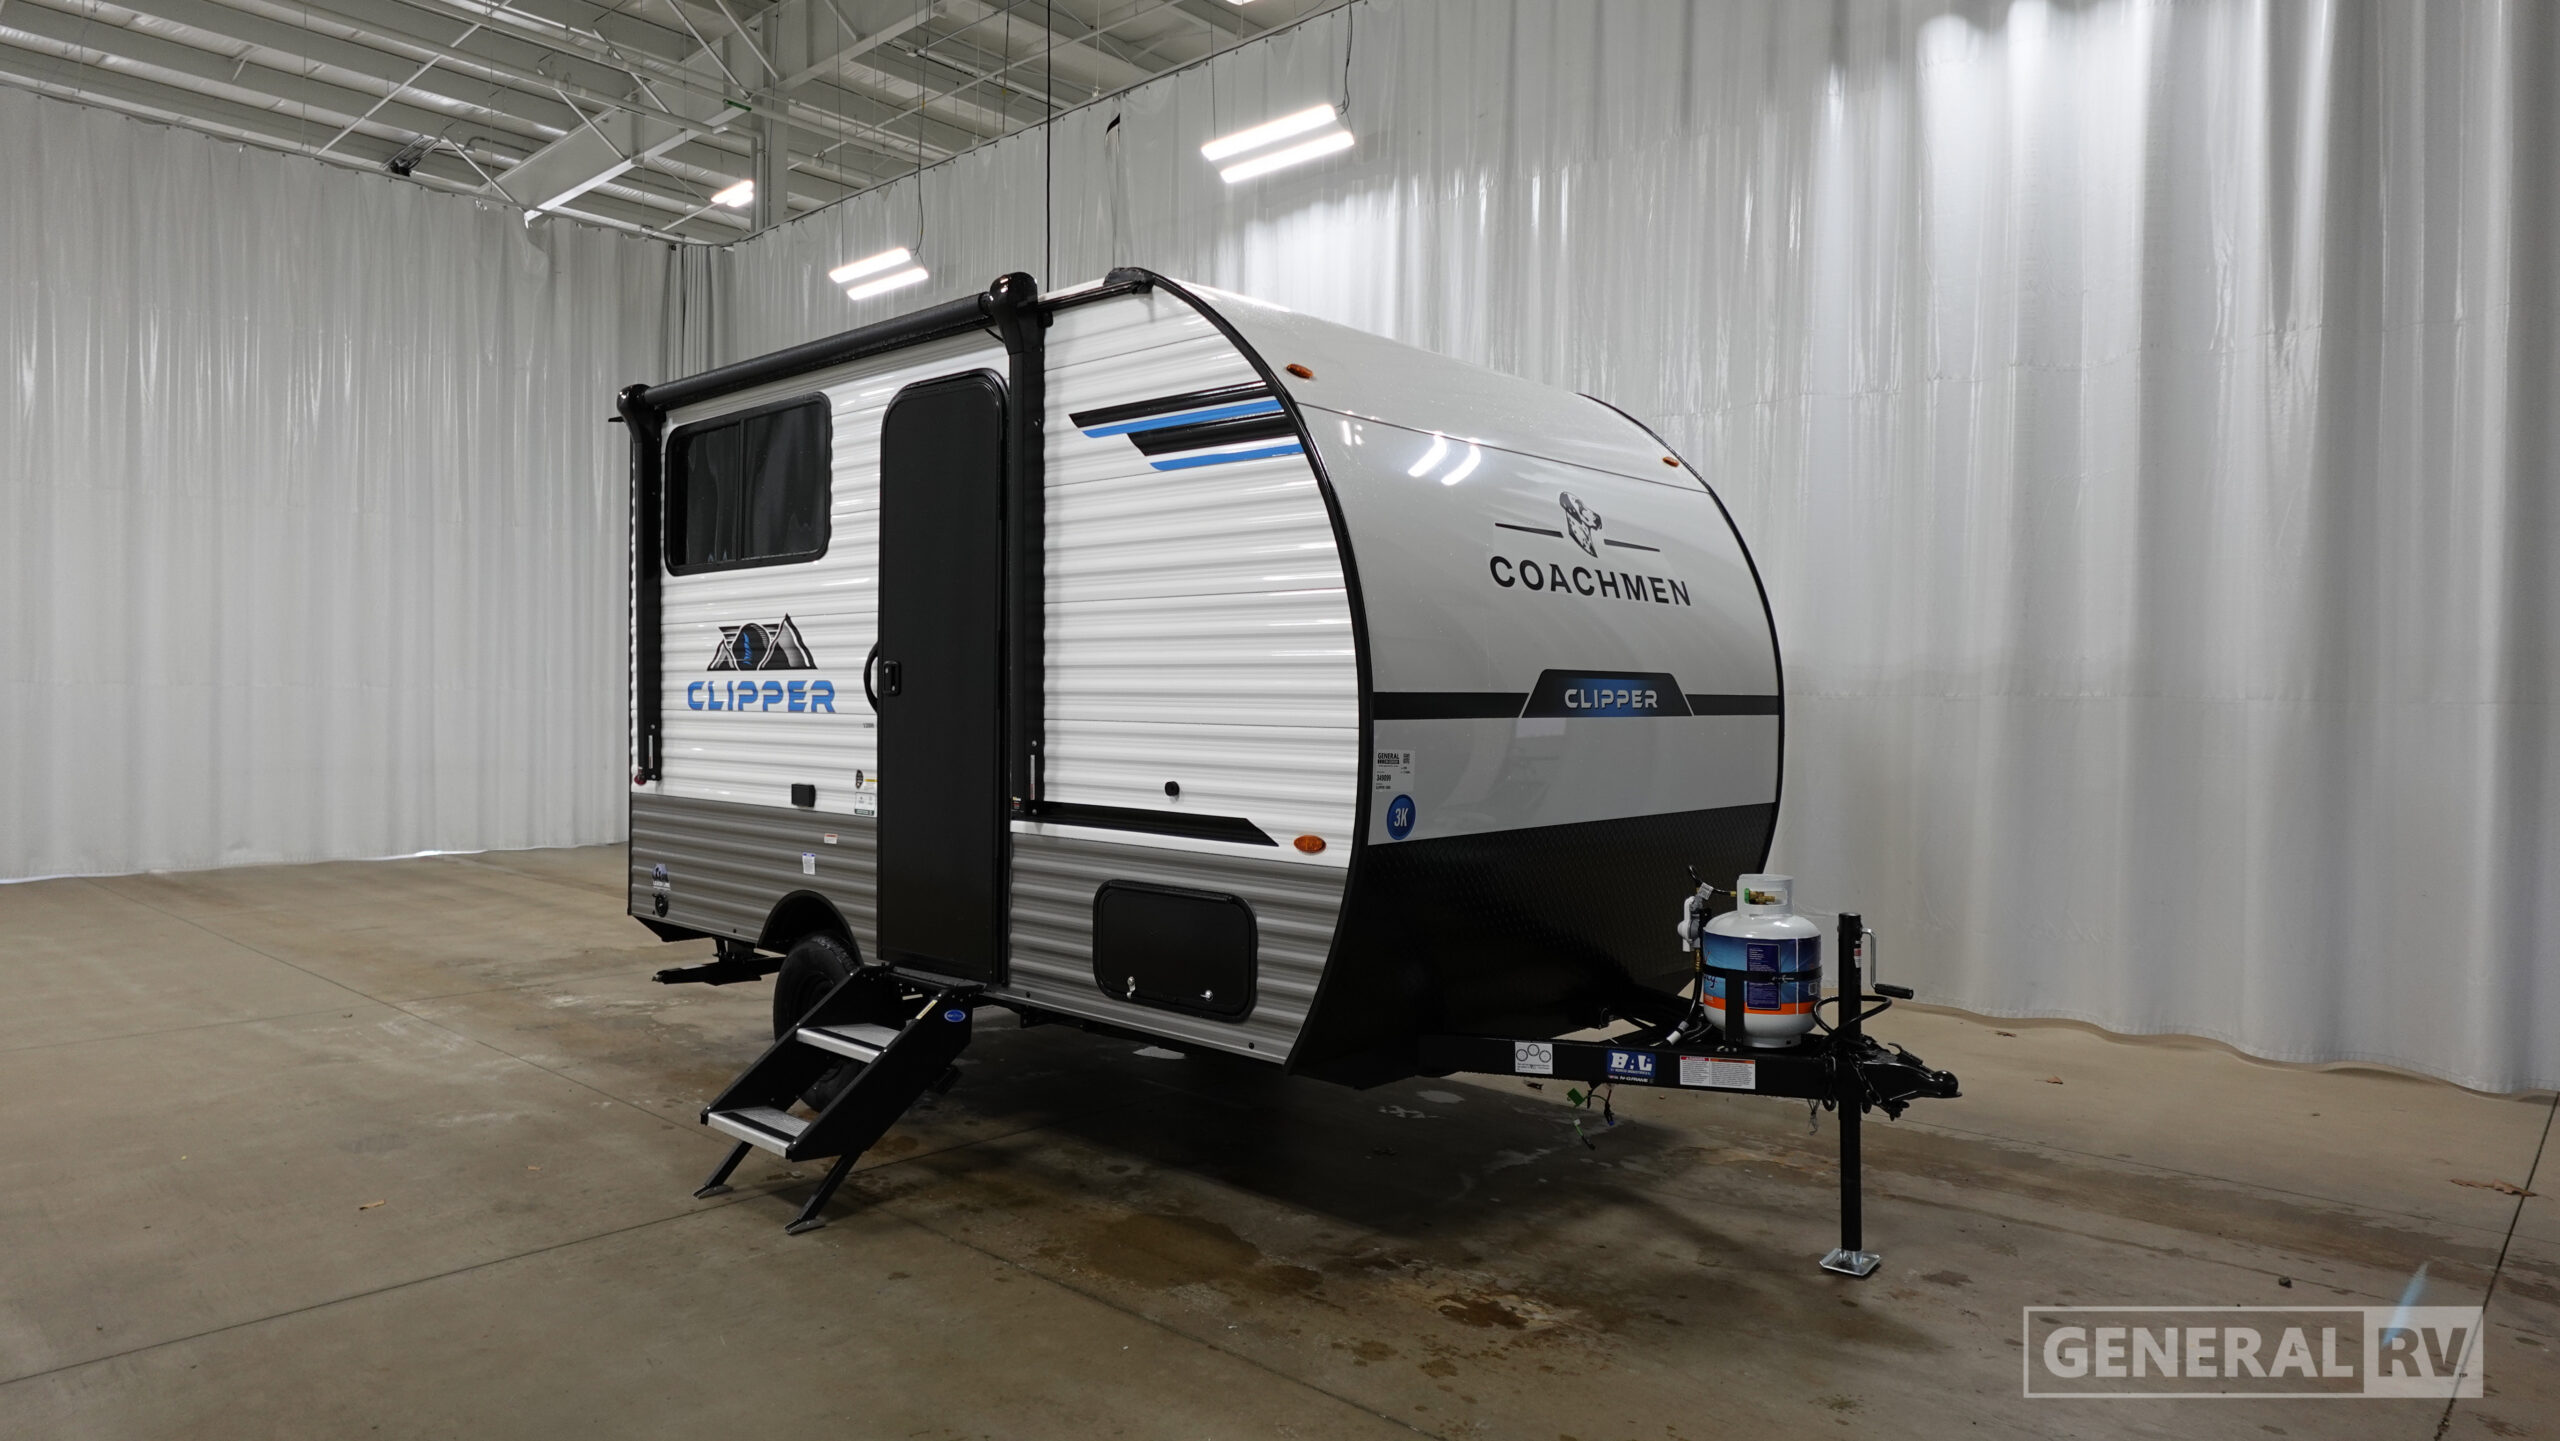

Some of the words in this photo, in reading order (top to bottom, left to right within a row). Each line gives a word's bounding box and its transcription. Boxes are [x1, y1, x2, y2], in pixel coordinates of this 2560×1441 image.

[1490, 555, 1691, 606] COACHMEN
[688, 680, 836, 713] CLIPPER
[1564, 689, 1658, 709] CLIPPER
[1377, 752, 1400, 760] GENERAL
[1394, 807, 1409, 827] 3K
[1610, 1052, 1653, 1072] BAL
